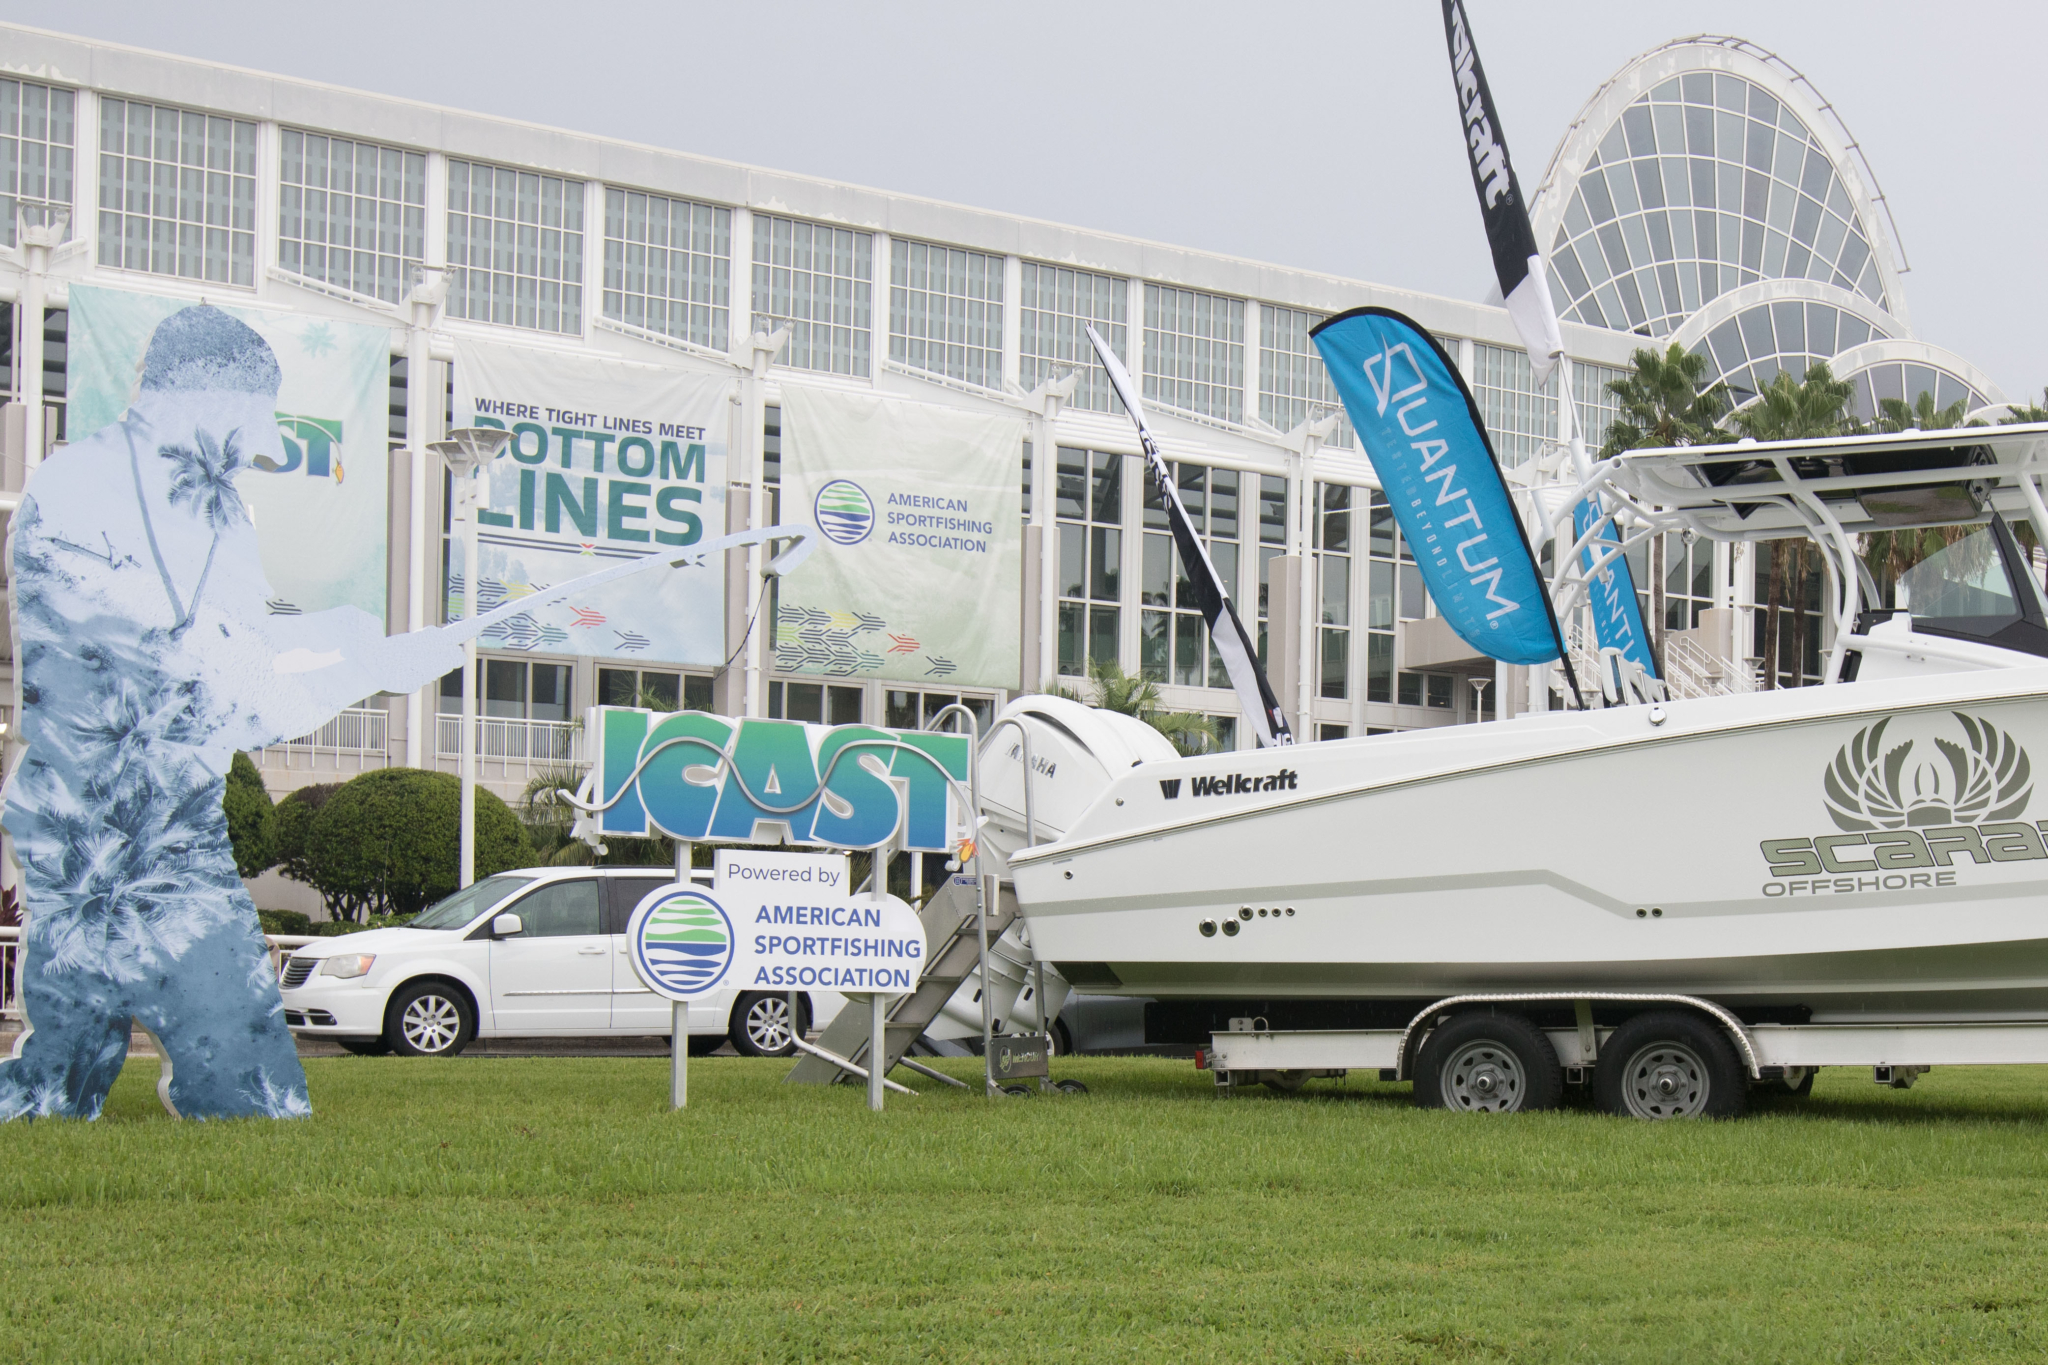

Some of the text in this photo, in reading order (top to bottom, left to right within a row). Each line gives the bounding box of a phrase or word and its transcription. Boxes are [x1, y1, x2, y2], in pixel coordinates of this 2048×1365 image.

[475, 397, 706, 441] WHERE TIGHT LINES MEET
[1363, 331, 1520, 620] QUANTUM
[887, 493, 968, 513] AMERICAN
[887, 512, 993, 535] SPORTFISHING
[1411, 498, 1447, 567] BEYOND
[888, 531, 986, 553] ASSOCIATION
[599, 705, 972, 852] ICAST
[1191, 768, 1298, 797] Wellcraft
[728, 863, 841, 887] Powered by
[1762, 870, 1957, 898] OFFSHORE
[755, 905, 881, 928] AMERICAN
[754, 935, 921, 959] SPORTFISHING
[754, 966, 910, 988] ASSOCIATION
